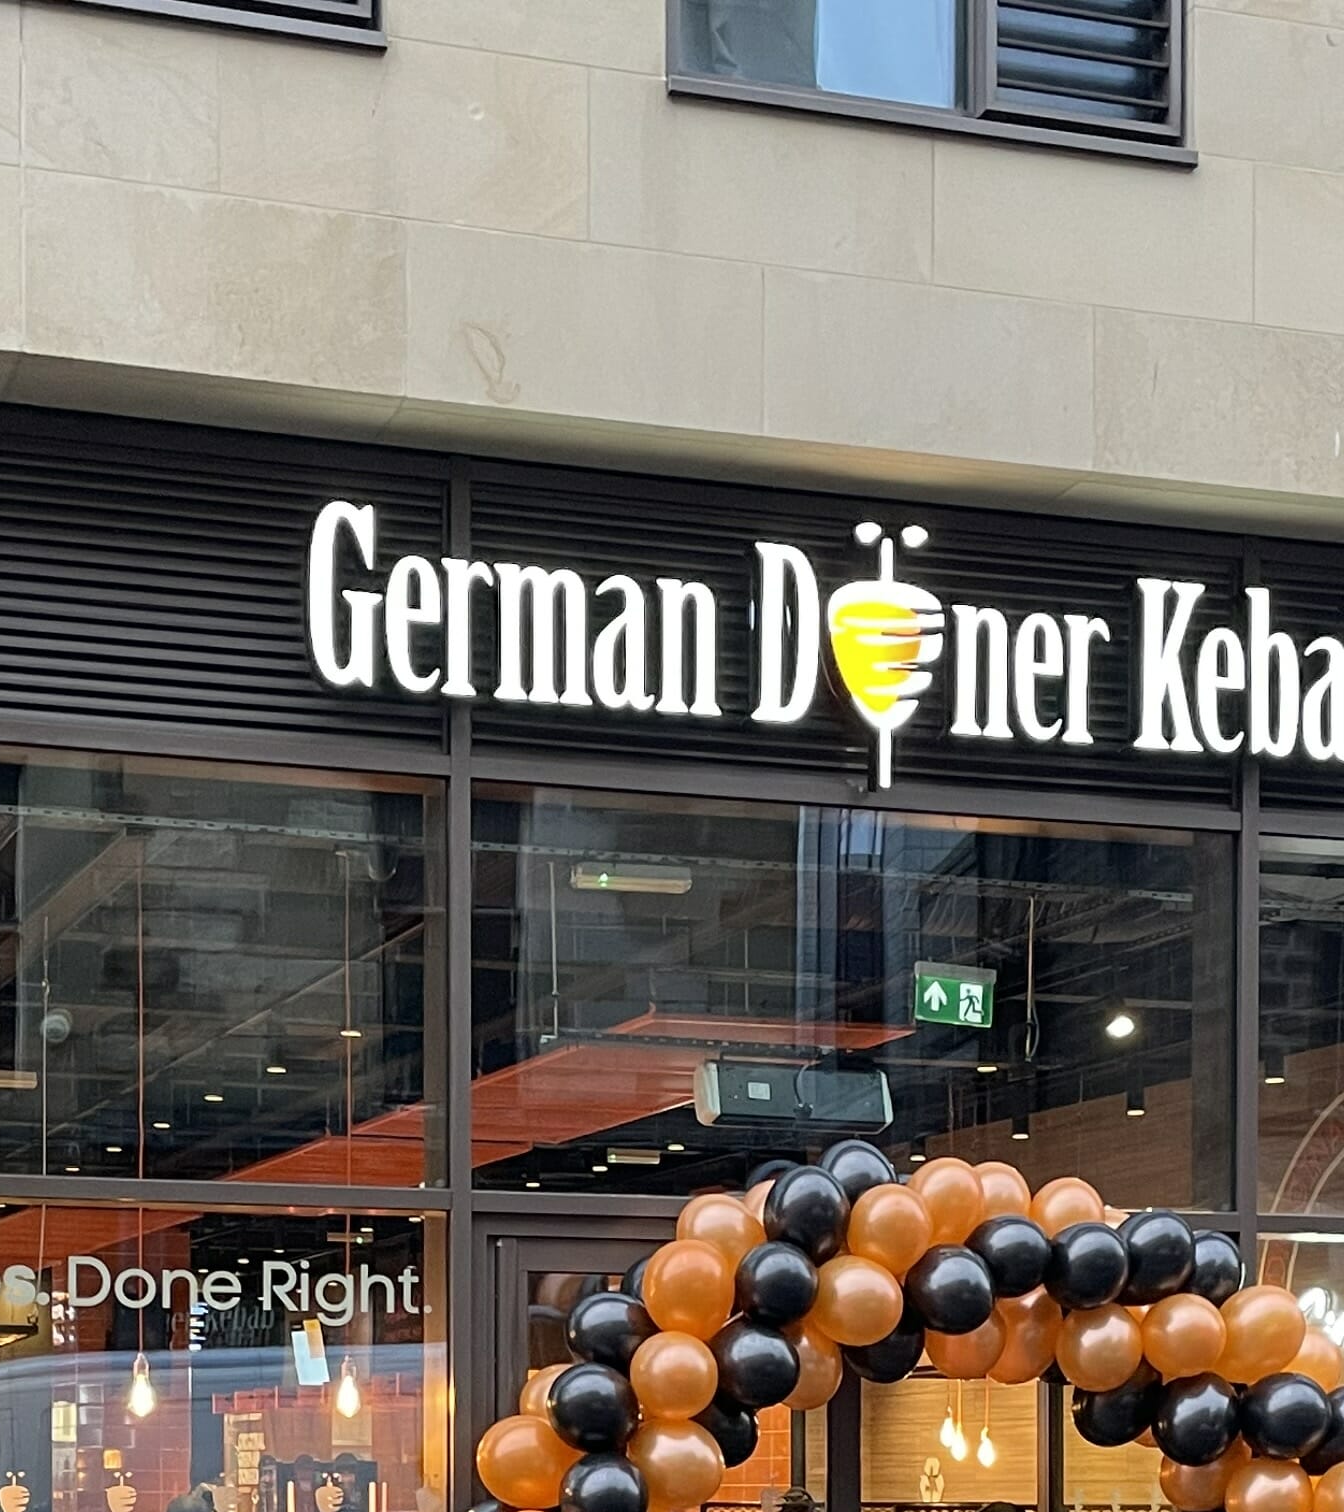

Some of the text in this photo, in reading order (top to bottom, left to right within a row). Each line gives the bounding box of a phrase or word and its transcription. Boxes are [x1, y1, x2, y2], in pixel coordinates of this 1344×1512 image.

[308, 502, 722, 718] German
[67, 1256, 242, 1311] Done
[262, 1260, 433, 1326] Right.
